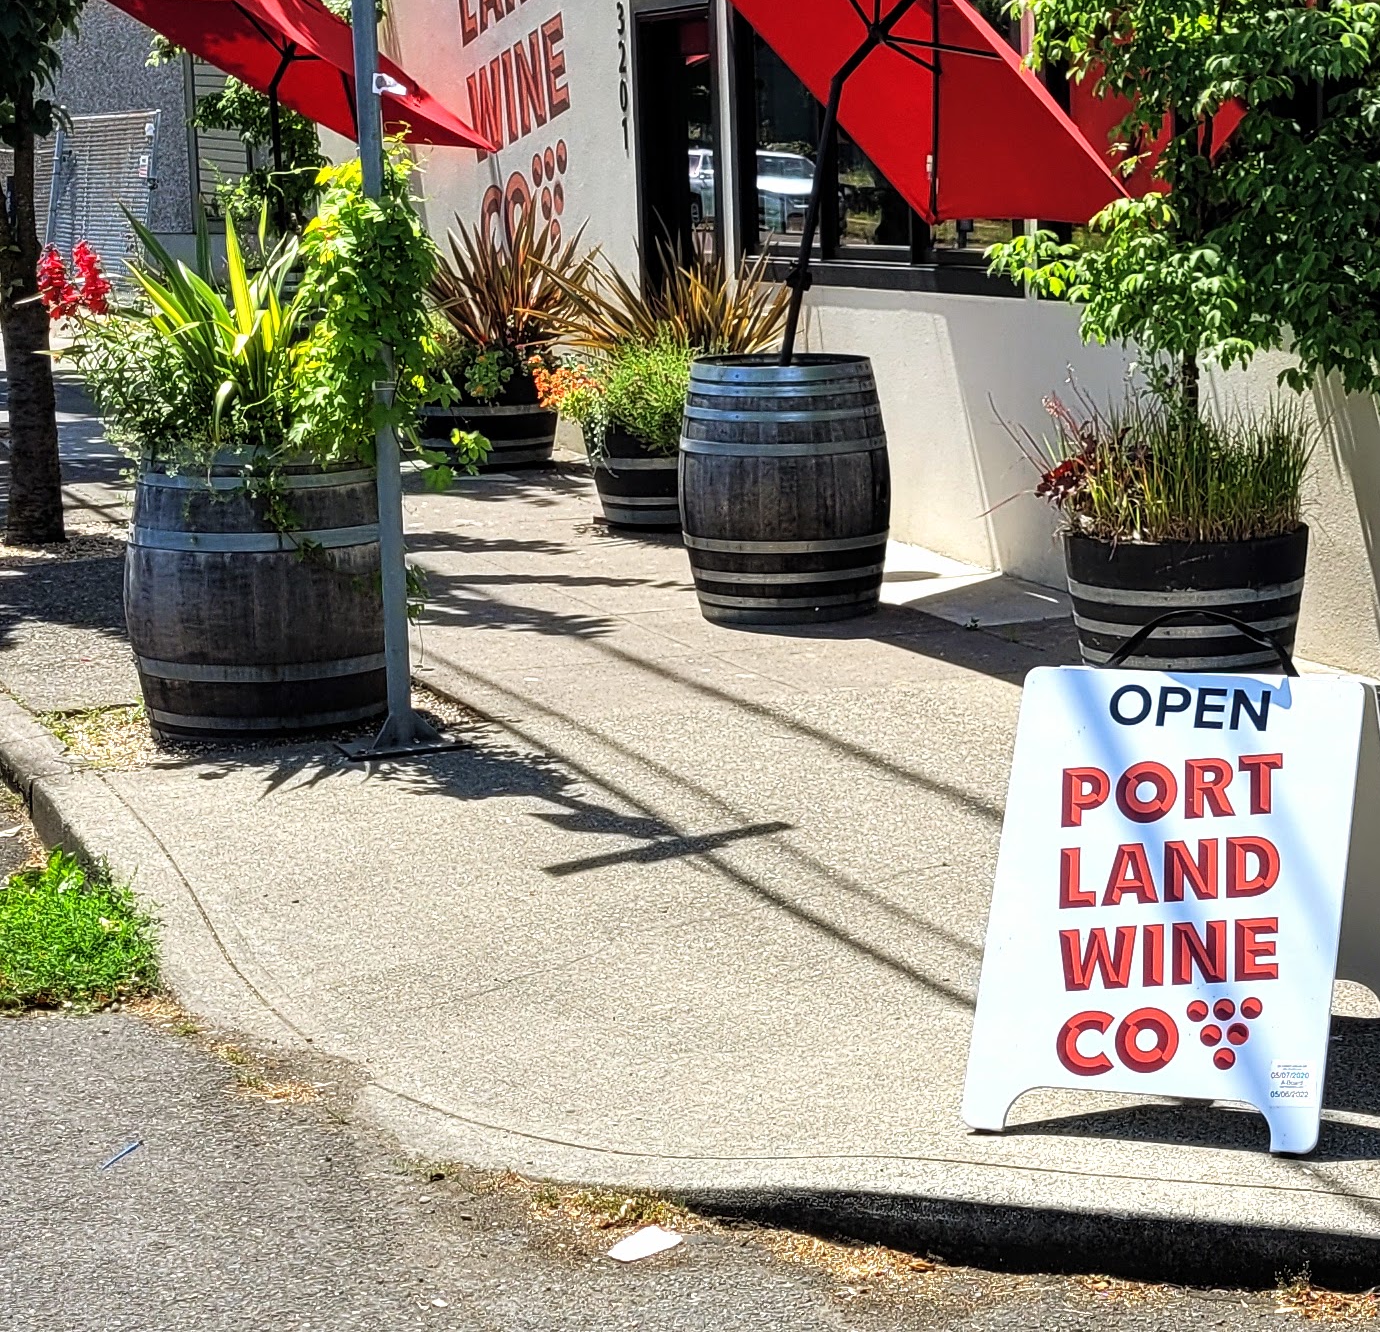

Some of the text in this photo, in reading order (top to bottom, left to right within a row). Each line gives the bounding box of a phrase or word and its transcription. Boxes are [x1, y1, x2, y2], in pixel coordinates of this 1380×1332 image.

[466, 11, 571, 163] WINE
[616, 1, 628, 152] 3201
[1109, 684, 1271, 732] OPEN
[1061, 753, 1283, 828] PORT
[1059, 836, 1280, 909] LAND
[1059, 917, 1279, 991] WINE
[1056, 1007, 1179, 1077] CO
